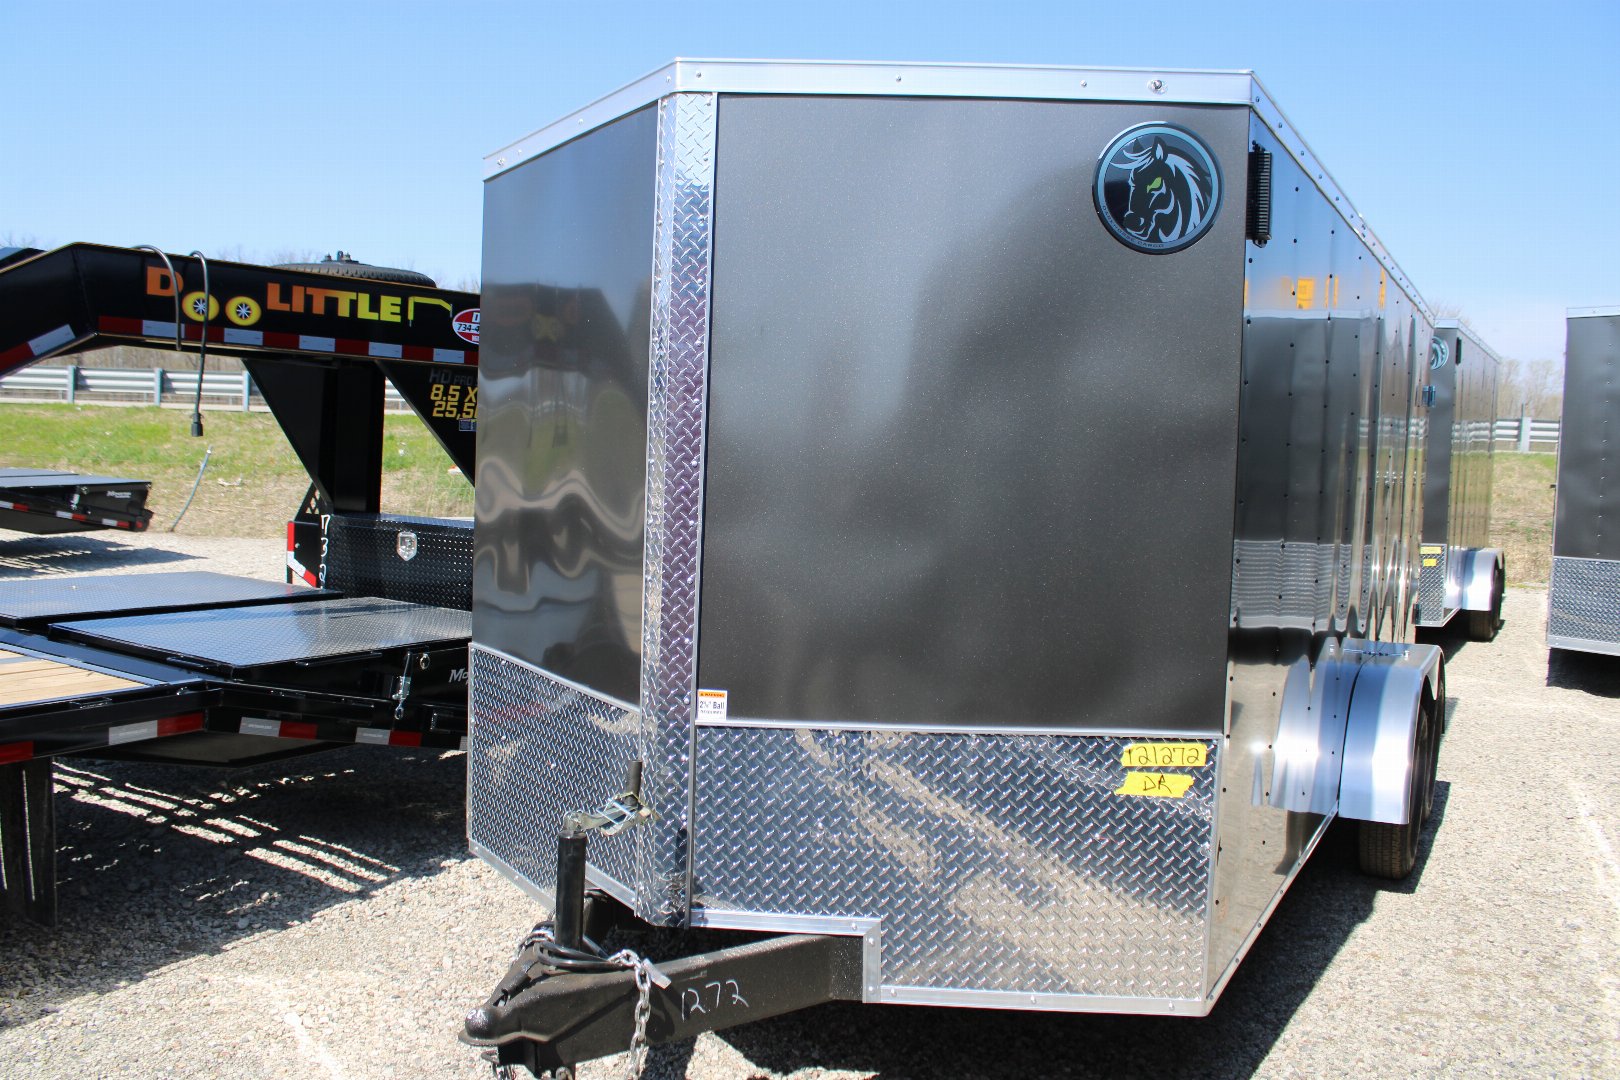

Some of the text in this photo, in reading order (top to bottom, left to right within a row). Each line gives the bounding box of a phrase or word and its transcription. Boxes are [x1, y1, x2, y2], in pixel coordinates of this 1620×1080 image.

[430, 384, 461, 402] 8.5
[713, 701, 725, 710] Ball
[1125, 746, 1199, 765] 121272
[681, 980, 749, 1022] 1272
